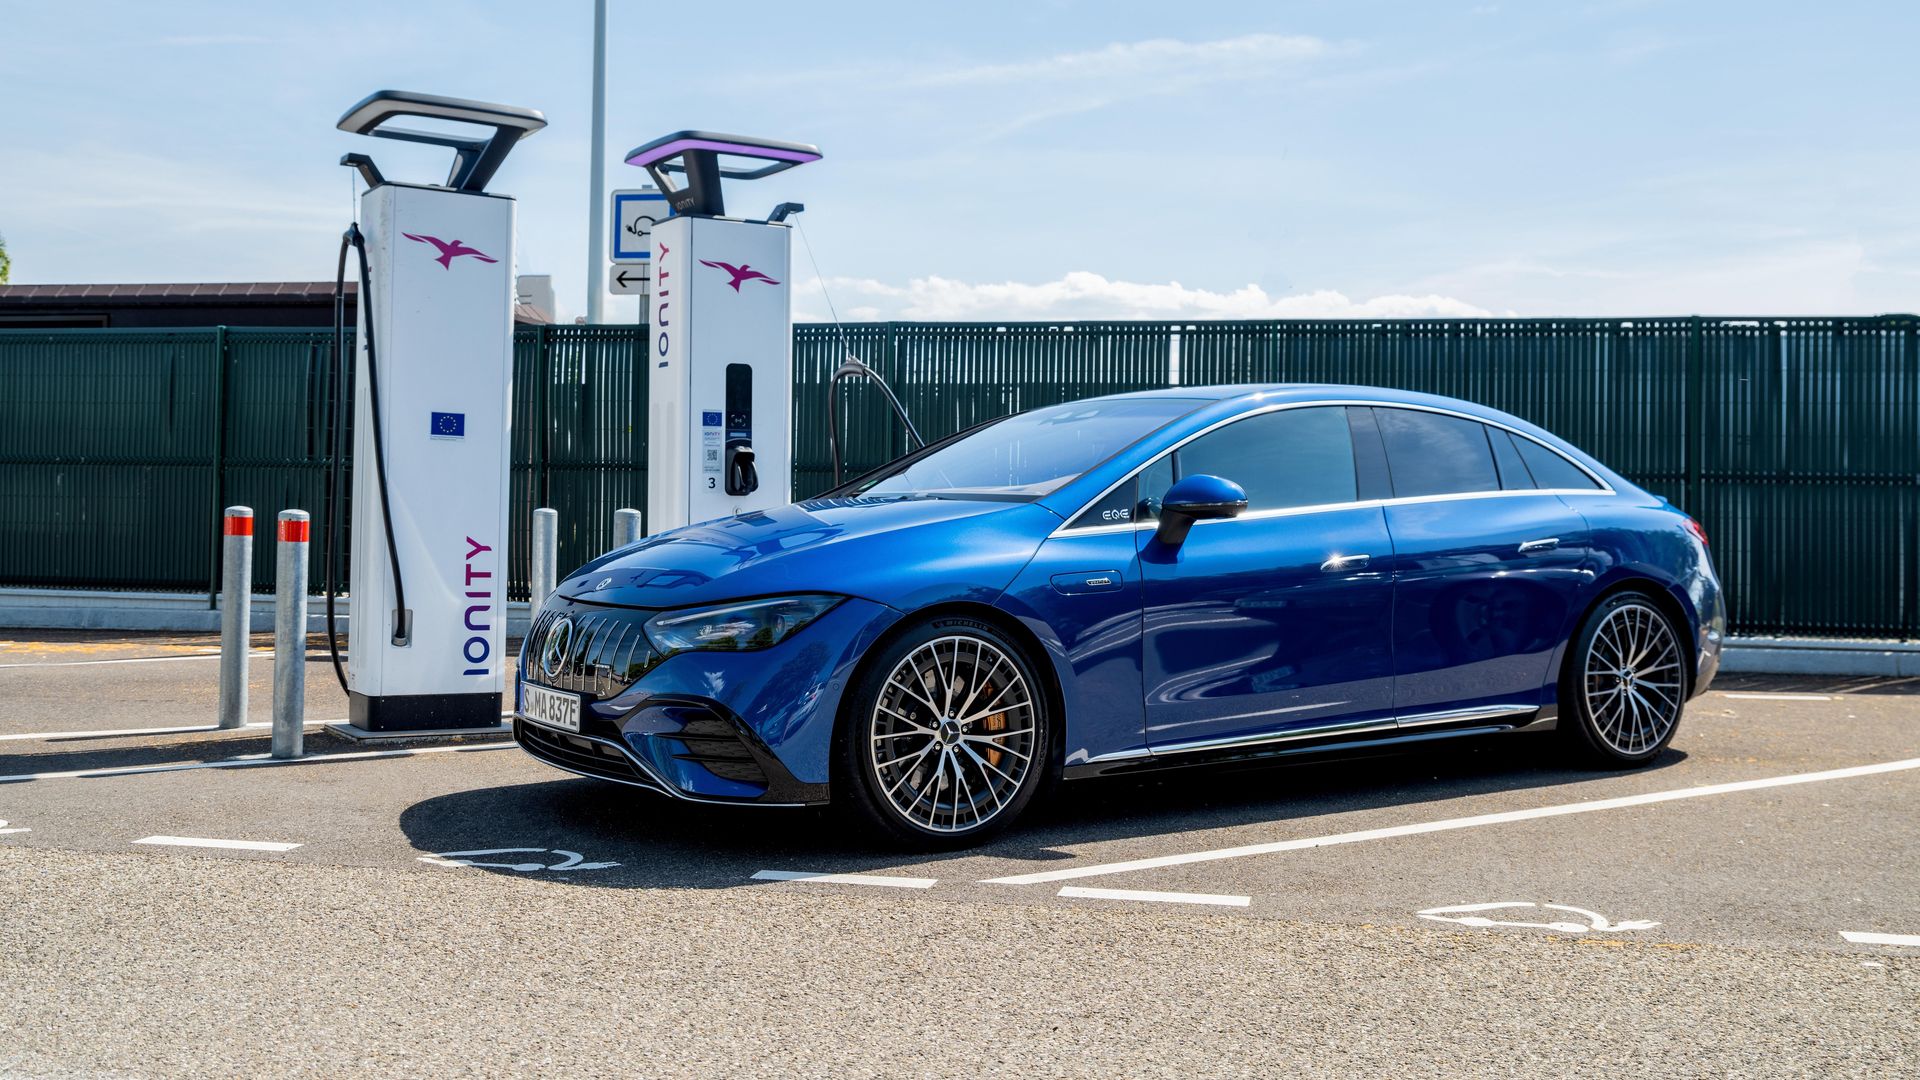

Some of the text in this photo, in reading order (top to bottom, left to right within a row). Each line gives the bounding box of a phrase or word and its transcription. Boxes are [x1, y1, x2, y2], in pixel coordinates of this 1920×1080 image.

[708, 477, 716, 489] 3
[1102, 508, 1130, 520] EQE
[463, 536, 492, 675] IONITY
[946, 620, 989, 631] MICHELIN
